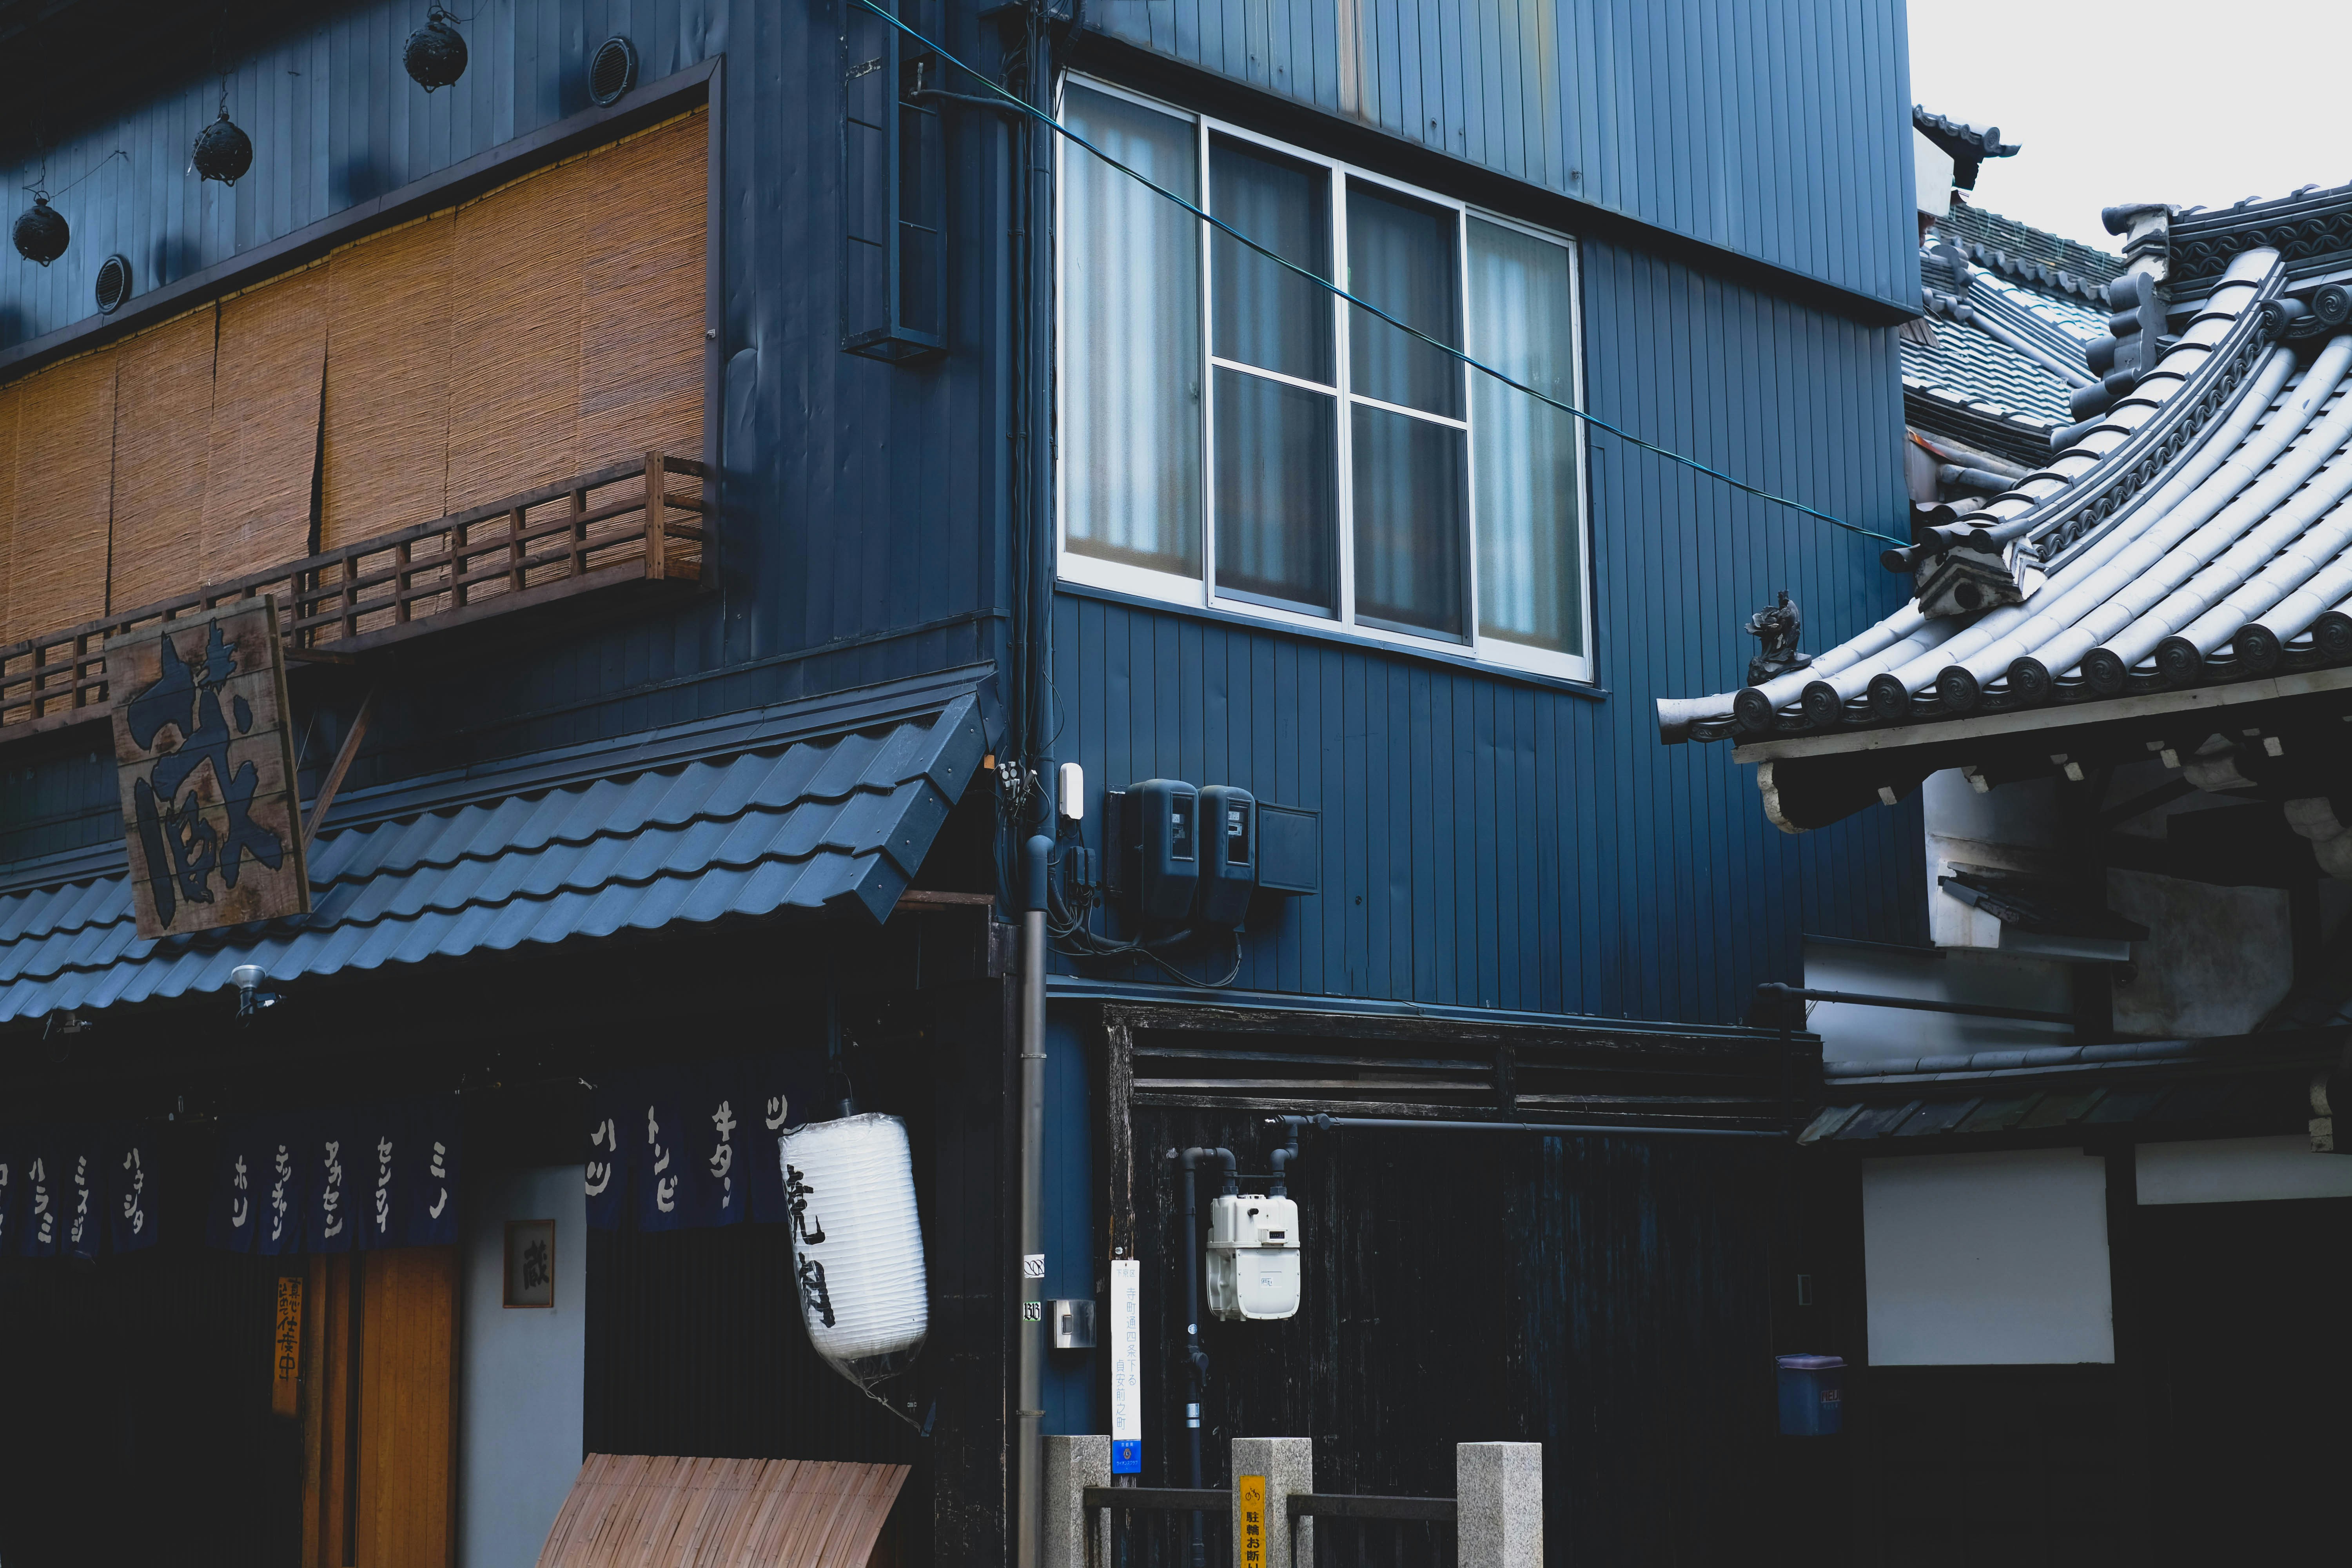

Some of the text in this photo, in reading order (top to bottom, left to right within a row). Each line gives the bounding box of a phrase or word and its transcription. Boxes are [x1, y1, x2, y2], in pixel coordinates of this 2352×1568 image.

[710, 1100, 737, 1209] 牛タン
[765, 1094, 794, 1134] ツ
[272, 1145, 291, 1241] テッチャン
[323, 1141, 342, 1238] アカセン
[376, 1136, 392, 1233] センマイ
[429, 1142, 447, 1219] ミノ
[585, 1119, 616, 1196] ハツ
[648, 1105, 678, 1213] トンビ
[29, 1158, 53, 1243] ハラミ
[289, 1278, 301, 1312] 真心
[523, 1240, 550, 1290] 蔵
[1127, 1287, 1136, 1386] 寺町通四条下る
[1116, 1359, 1126, 1430] 貞安前之町
